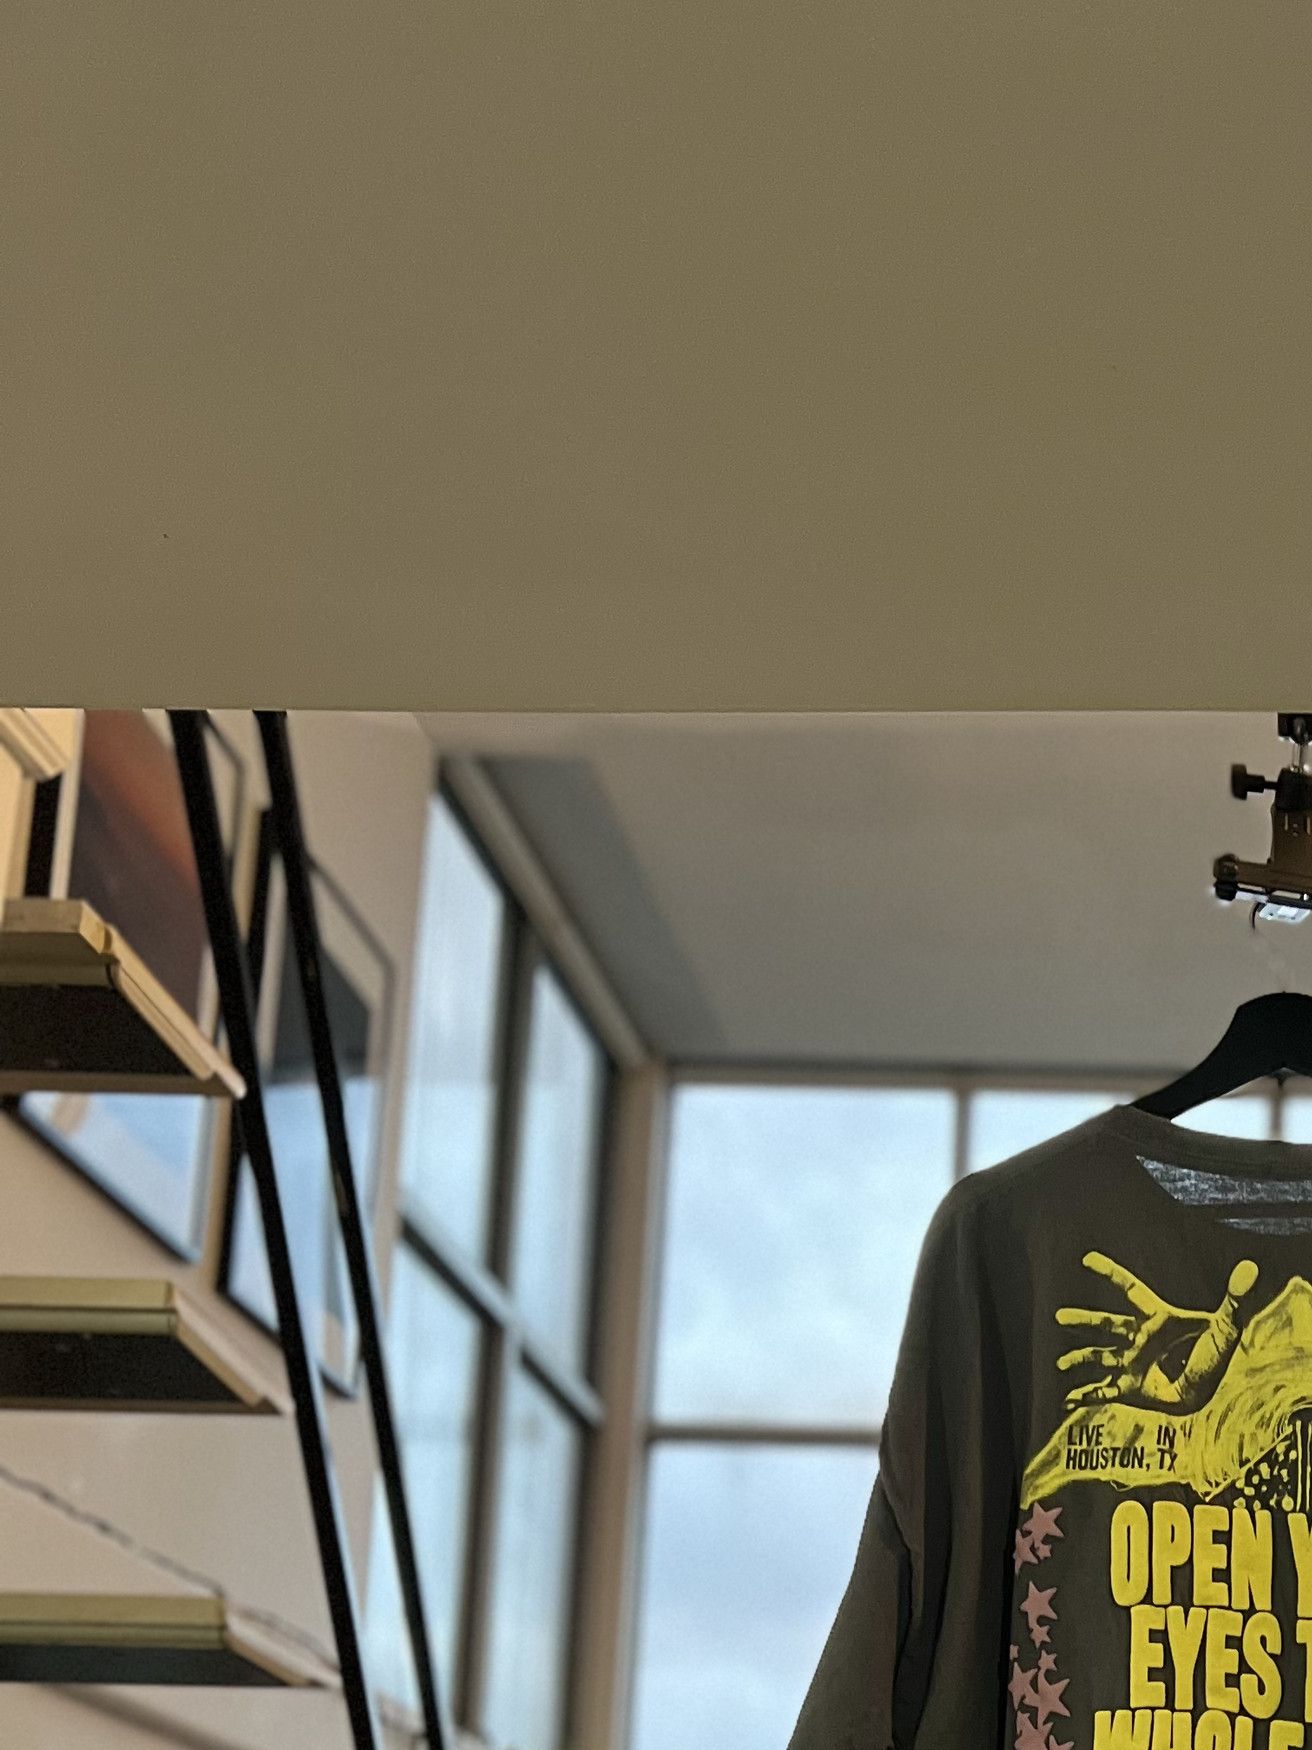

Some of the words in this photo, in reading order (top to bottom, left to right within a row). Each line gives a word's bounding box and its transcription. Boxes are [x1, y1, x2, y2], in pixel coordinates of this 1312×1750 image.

[1066, 1446, 1151, 1472] HOUSTON,
[1157, 1447, 1178, 1473] TX
[1067, 1424, 1104, 1446] LIVE
[1156, 1424, 1177, 1448] IN
[1110, 1500, 1273, 1611] OPEN
[1130, 1604, 1282, 1719] EYES
